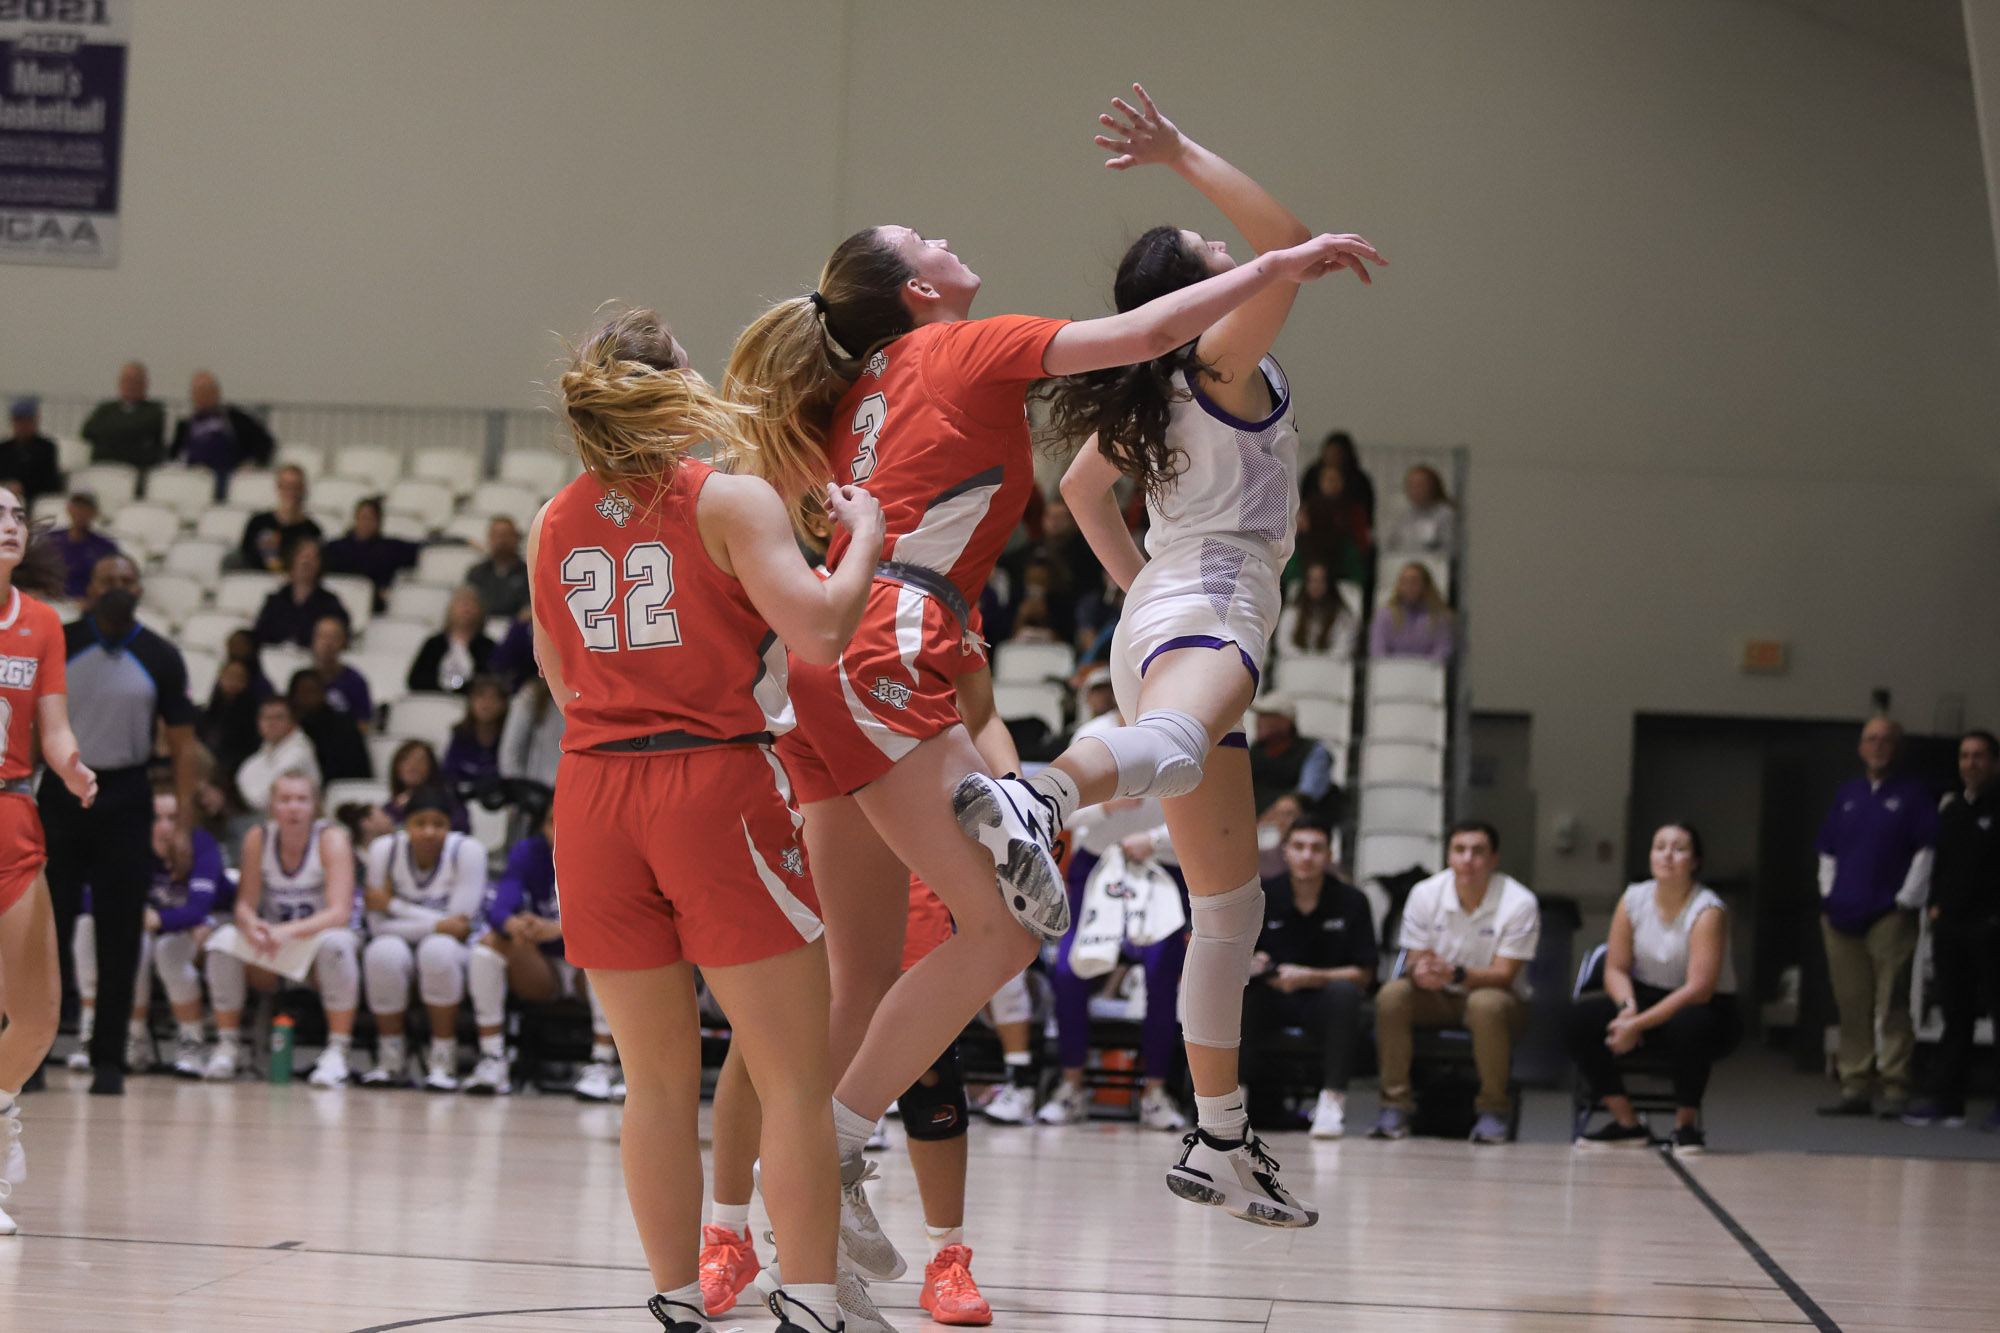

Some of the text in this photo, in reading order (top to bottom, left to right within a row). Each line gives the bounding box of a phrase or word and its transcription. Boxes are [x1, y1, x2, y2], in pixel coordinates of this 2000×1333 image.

[0, 96, 106, 133] asketball
[851, 391, 887, 485] 3
[560, 541, 683, 652] 22
[878, 684, 910, 701] RGV
